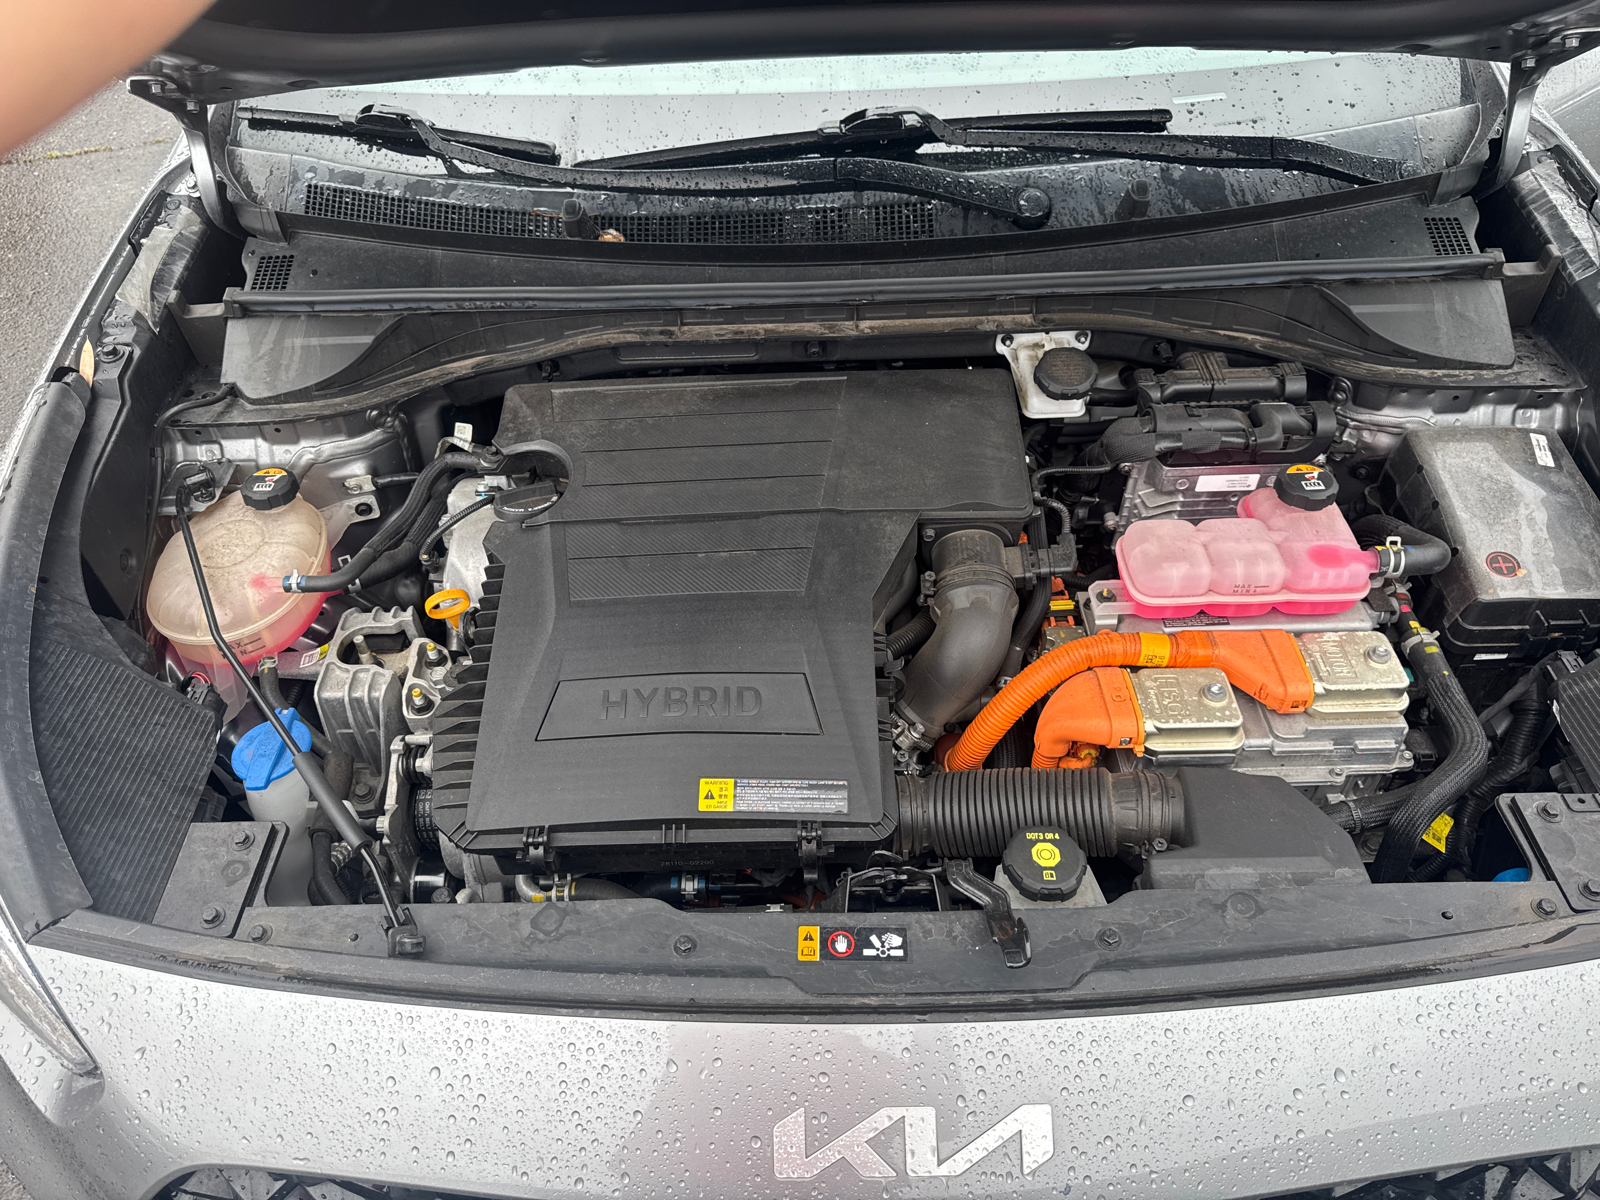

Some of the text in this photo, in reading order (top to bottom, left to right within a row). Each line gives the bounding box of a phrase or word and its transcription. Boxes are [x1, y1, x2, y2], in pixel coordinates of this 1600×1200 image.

[1322, 641, 1352, 677] MOTOR
[600, 685, 763, 720] HYBRID
[1026, 832, 1060, 840] DOT3 OR 4
